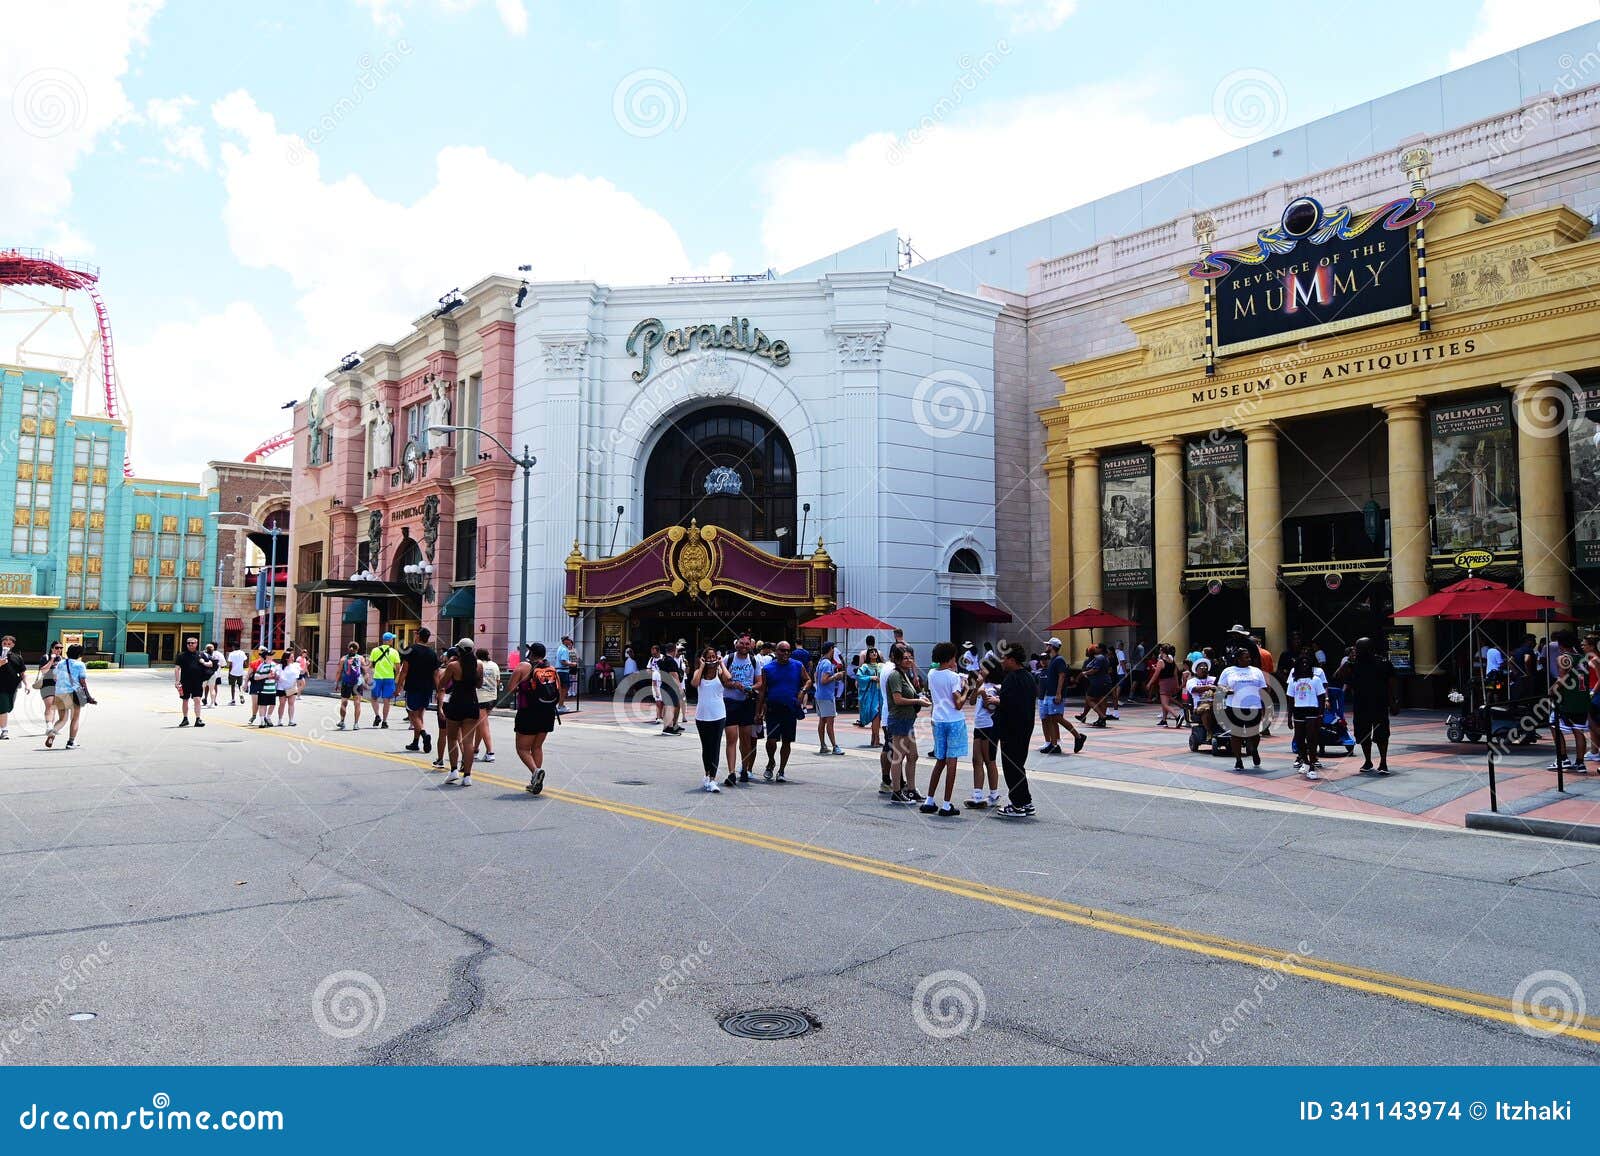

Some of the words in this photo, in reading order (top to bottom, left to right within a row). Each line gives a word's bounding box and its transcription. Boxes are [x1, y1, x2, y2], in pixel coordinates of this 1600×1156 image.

[1232, 261, 1310, 290] REVENGE
[1319, 253, 1341, 267] OF
[1350, 241, 1386, 259] THE
[1233, 261, 1386, 320] MUMMY
[626, 315, 792, 383] Paradise
[1191, 378, 1272, 403] MUSEUM
[1284, 371, 1308, 386] OF
[1322, 339, 1476, 379] ANTIQUITIES
[1436, 405, 1503, 421] MUMMY
[1467, 417, 1505, 426] MUSEUM
[1189, 444, 1238, 457] MUMMY
[1104, 457, 1146, 469] MUMMY
[1458, 554, 1491, 567] EXPRESS
